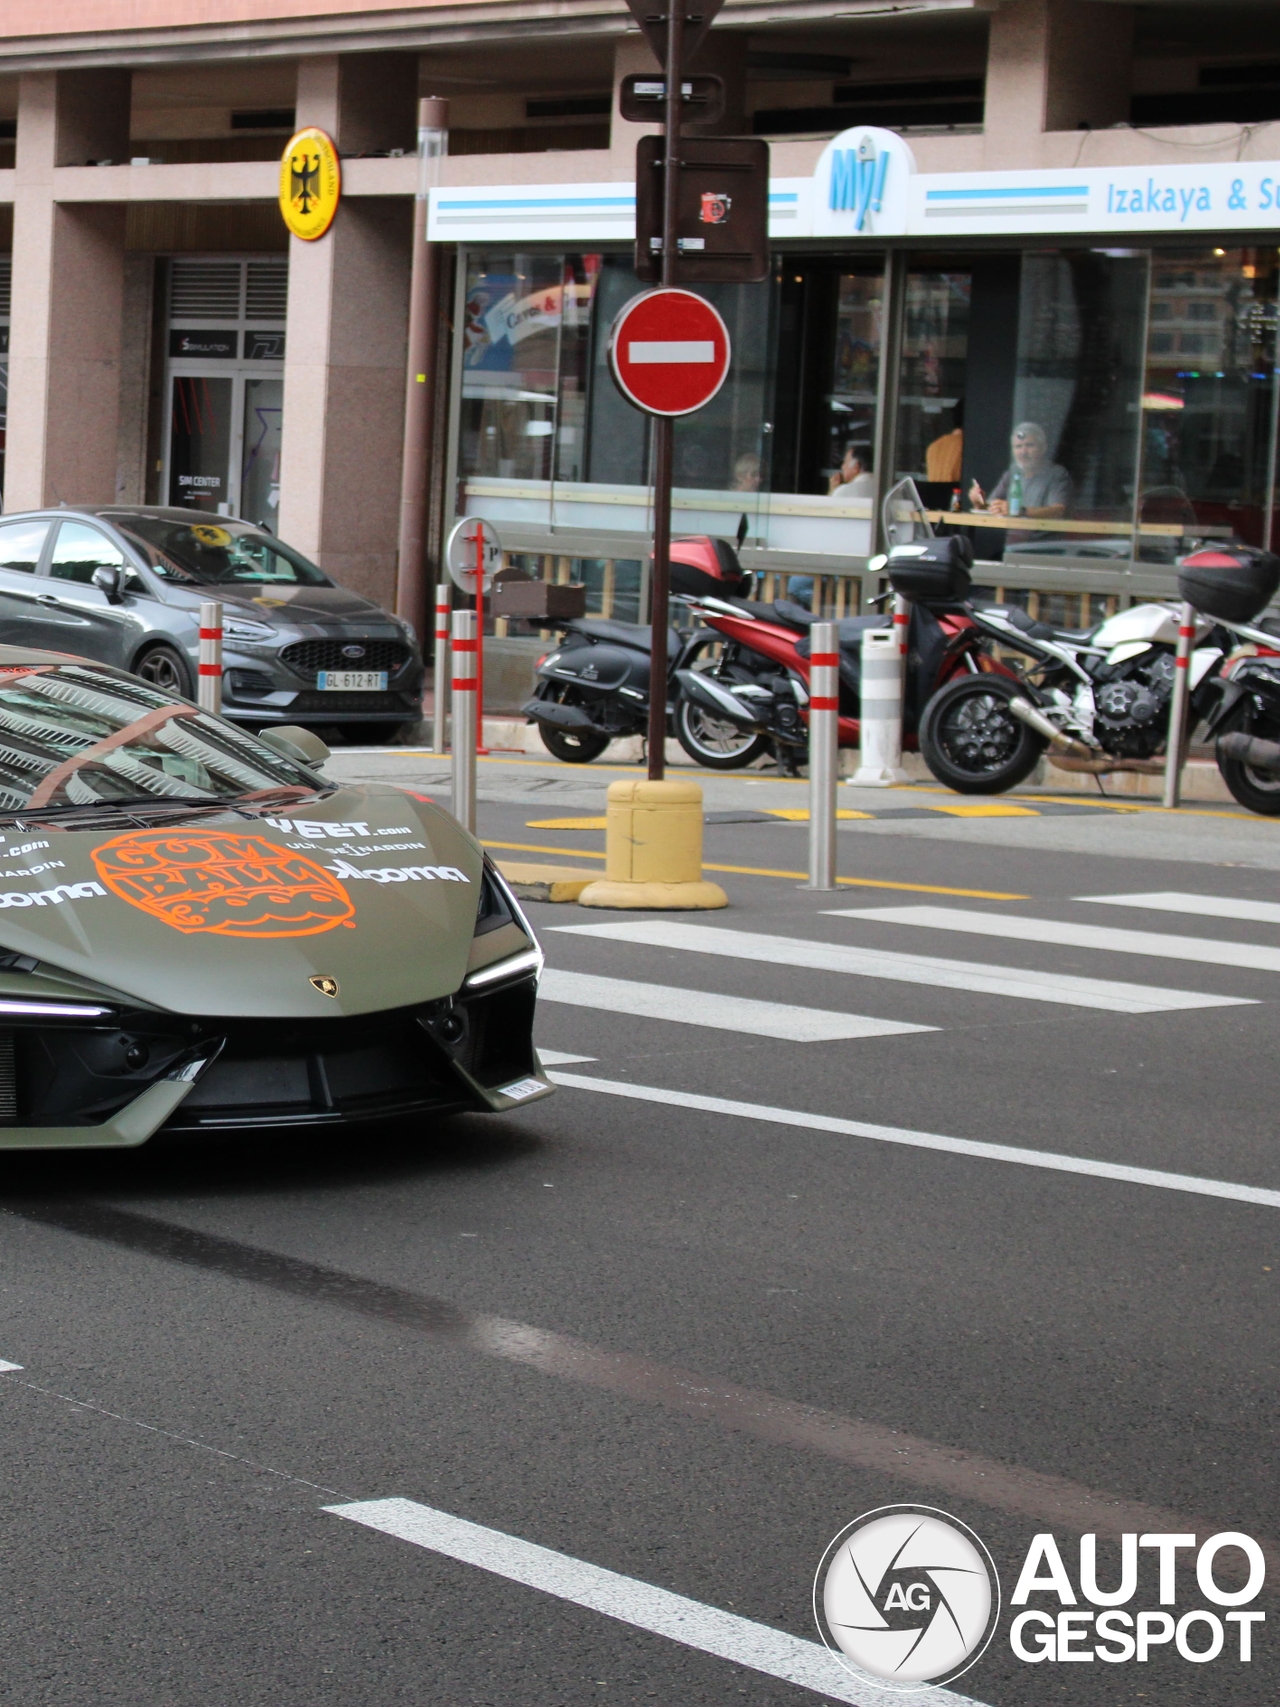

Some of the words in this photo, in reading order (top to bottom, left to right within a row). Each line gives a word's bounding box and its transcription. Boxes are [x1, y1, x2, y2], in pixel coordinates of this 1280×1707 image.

[1107, 178, 1212, 222] Izakaya
[1228, 178, 1247, 210] &
[1259, 177, 1280, 209] S
[178, 475, 192, 486] SIM
[193, 476, 220, 488] CENTER
[326, 673, 380, 688] GL-612-RT
[266, 817, 412, 840] YEET.com
[357, 841, 426, 854] NARDIN
